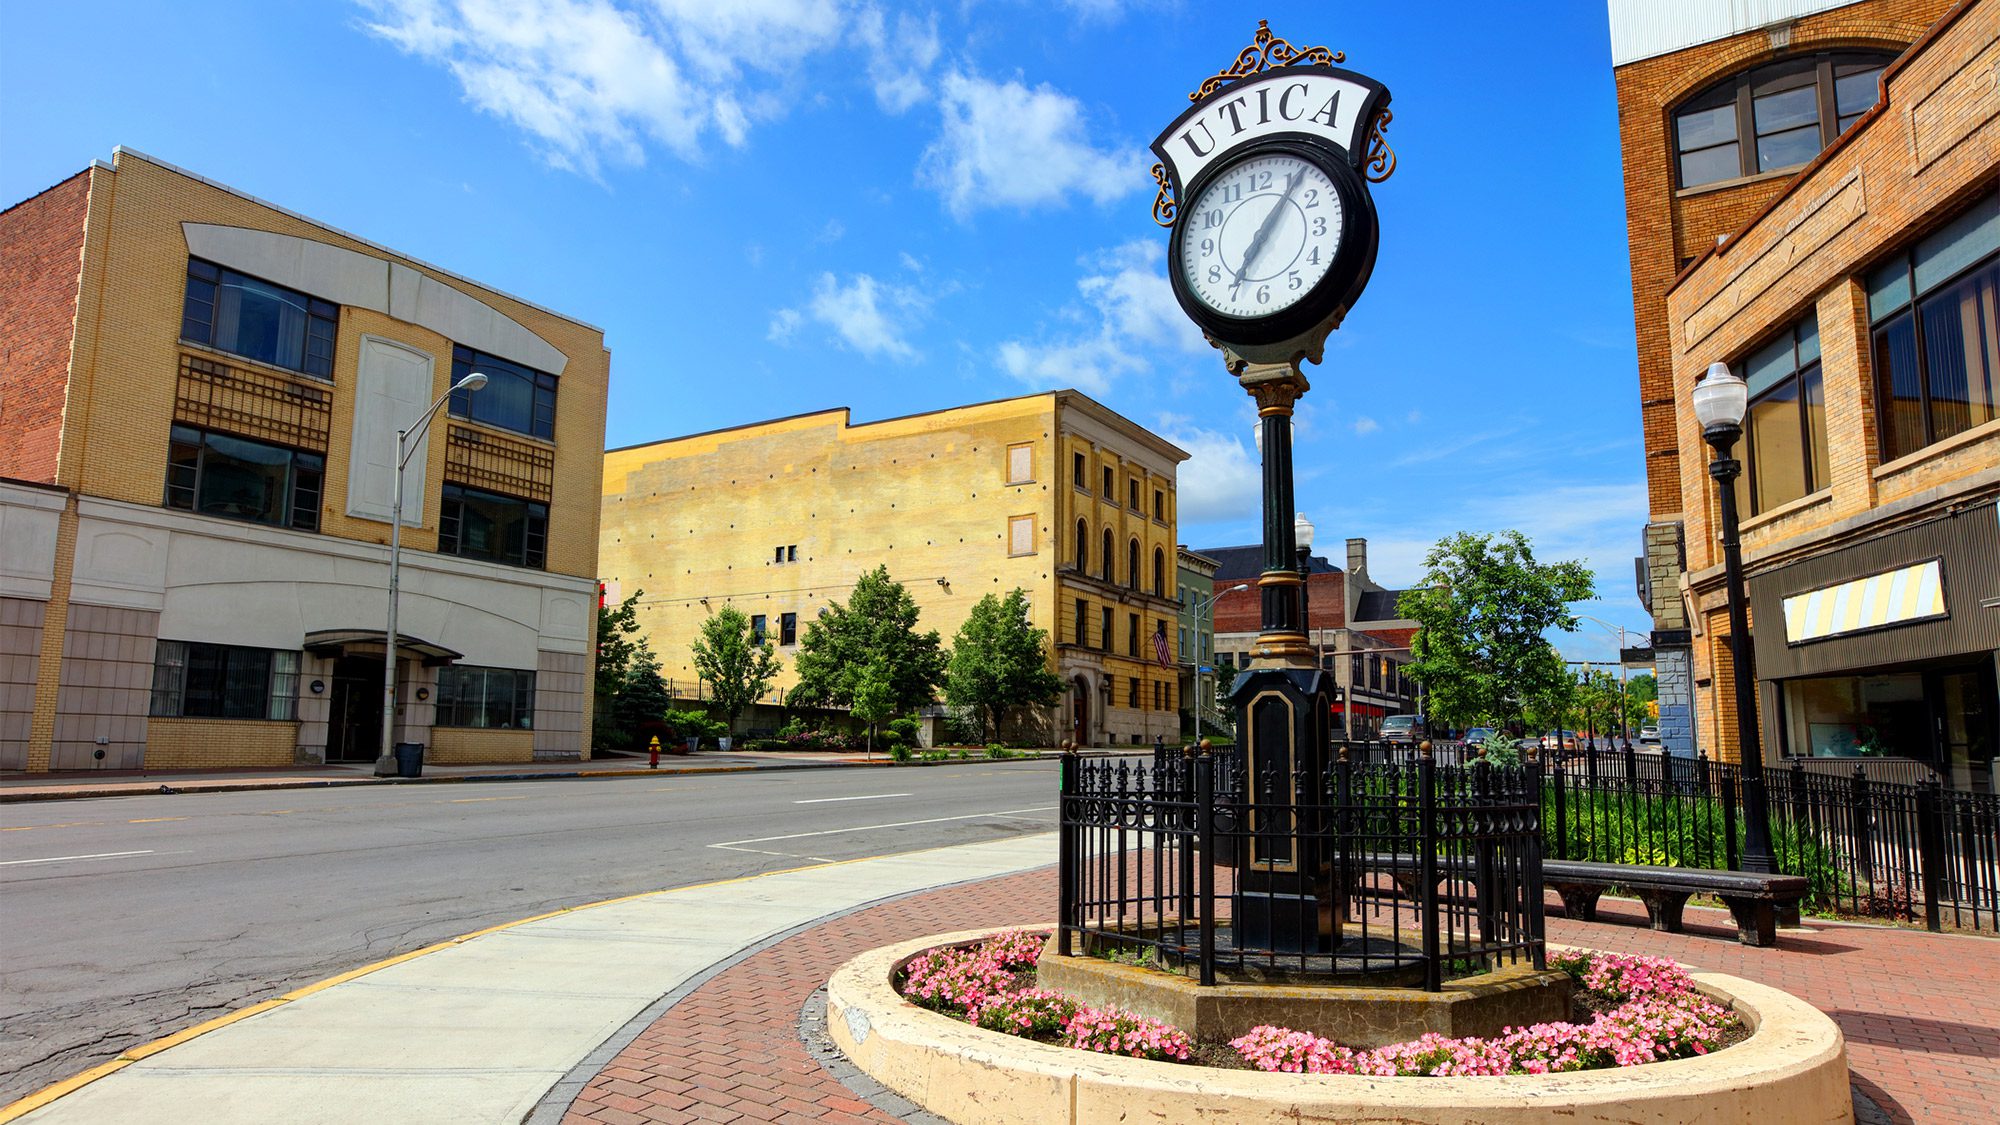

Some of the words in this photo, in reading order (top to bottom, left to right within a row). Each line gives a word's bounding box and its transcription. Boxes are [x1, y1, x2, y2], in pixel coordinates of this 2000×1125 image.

[1179, 83, 1341, 158] UTICA
[1247, 170, 1273, 193] 12
[1222, 182, 1244, 204] 11
[1304, 188, 1319, 209] 2
[1201, 208, 1223, 230] 10
[1312, 216, 1327, 236] 3
[1201, 238, 1214, 257] 9
[1306, 246, 1320, 265] 4
[1208, 265, 1221, 284] 8
[1288, 270, 1303, 290] 5
[1228, 282, 1241, 302] 7
[1256, 285, 1270, 305] 6
